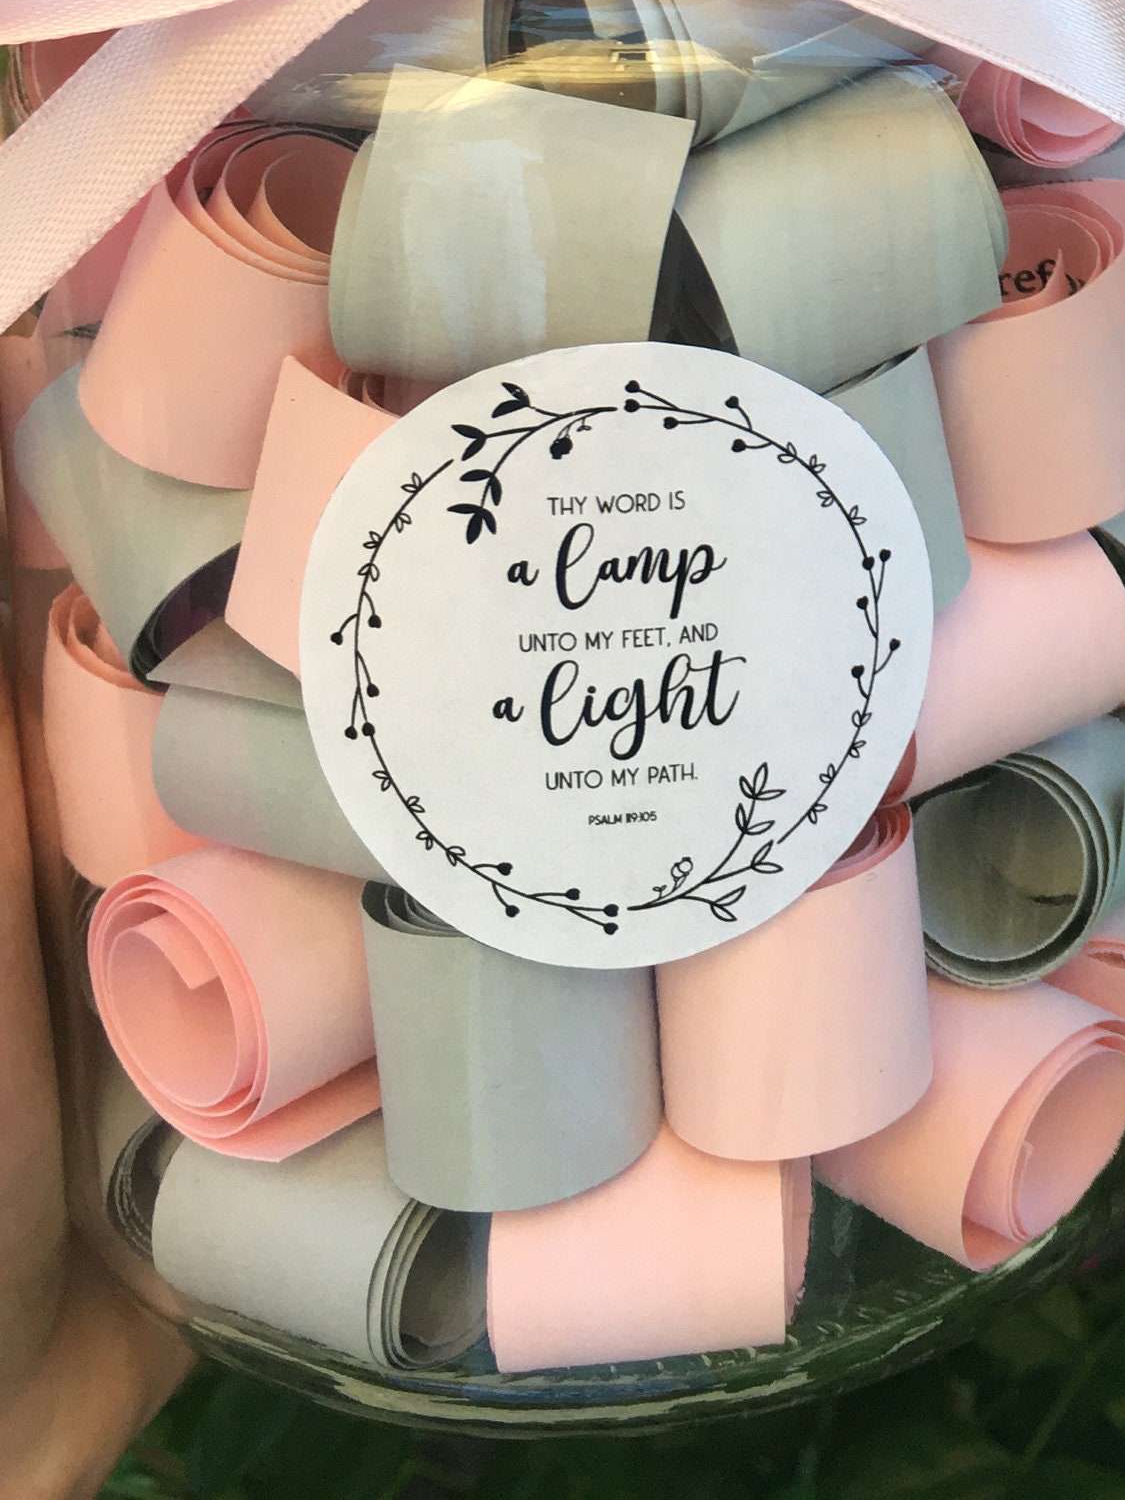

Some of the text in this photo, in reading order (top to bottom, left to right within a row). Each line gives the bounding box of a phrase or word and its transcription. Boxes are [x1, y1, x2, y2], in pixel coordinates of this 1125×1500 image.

[546, 490, 686, 516] THY WORD IS
[506, 522, 728, 620] a lamp
[518, 622, 719, 653] UNTO MY FEET, AND
[491, 649, 747, 761] a light
[545, 762, 698, 791] UNTO MY PATH.
[588, 814, 623, 826] PSALM
